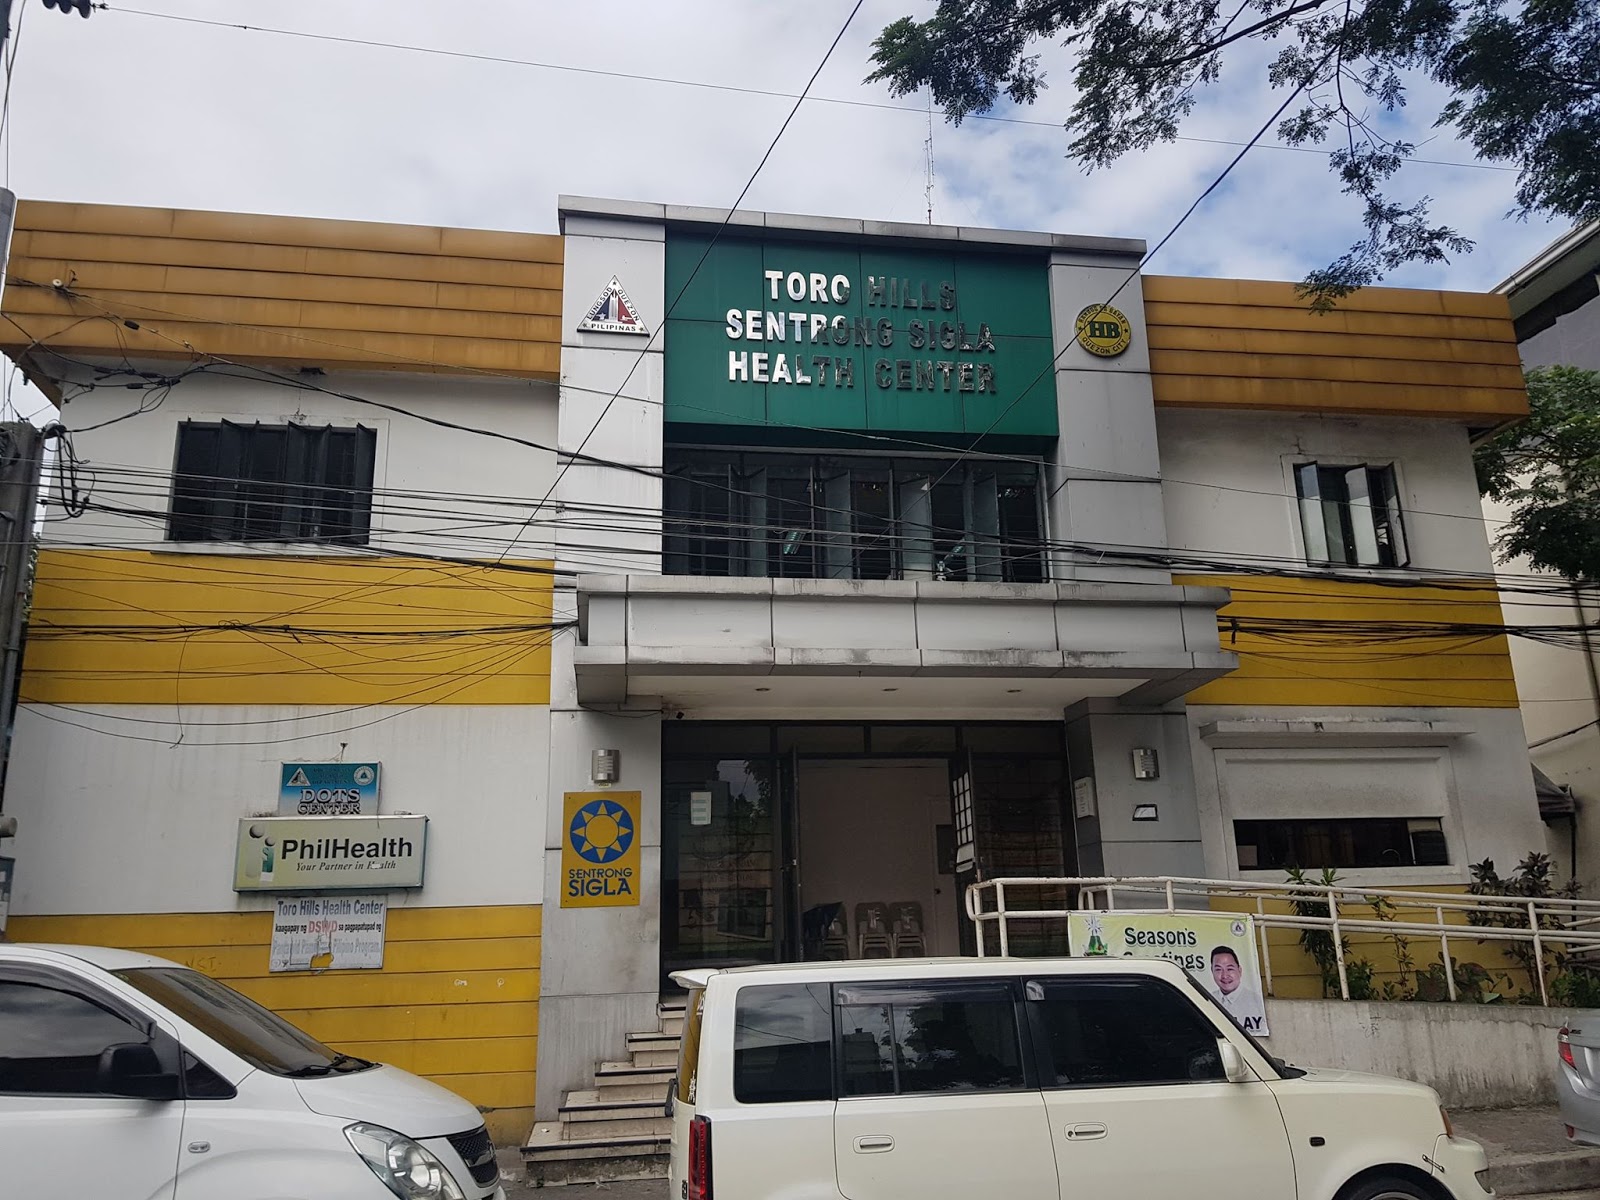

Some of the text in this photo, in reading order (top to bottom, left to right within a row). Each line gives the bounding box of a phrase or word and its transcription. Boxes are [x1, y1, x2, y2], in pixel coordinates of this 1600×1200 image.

[765, 270, 955, 311] TORO HILLS
[617, 288, 640, 321] QUEZON
[591, 323, 637, 332] PILIPINAS
[726, 309, 995, 353] SENTRONG SIGLA
[1089, 320, 1121, 339] HB
[1082, 336, 1127, 354] QUEZON CITY
[728, 350, 997, 393] HEALTH CENTER
[301, 788, 361, 804] DOTS
[297, 802, 361, 815] CENTER
[281, 838, 413, 860] PhilHealth
[296, 860, 397, 872] Your Partner in Halth
[568, 867, 633, 879] SENTRONG
[568, 878, 632, 897] SIGLA
[278, 900, 384, 916] Toro Hills Health Center
[308, 920, 338, 935] DSWD
[338, 923, 344, 931] sa
